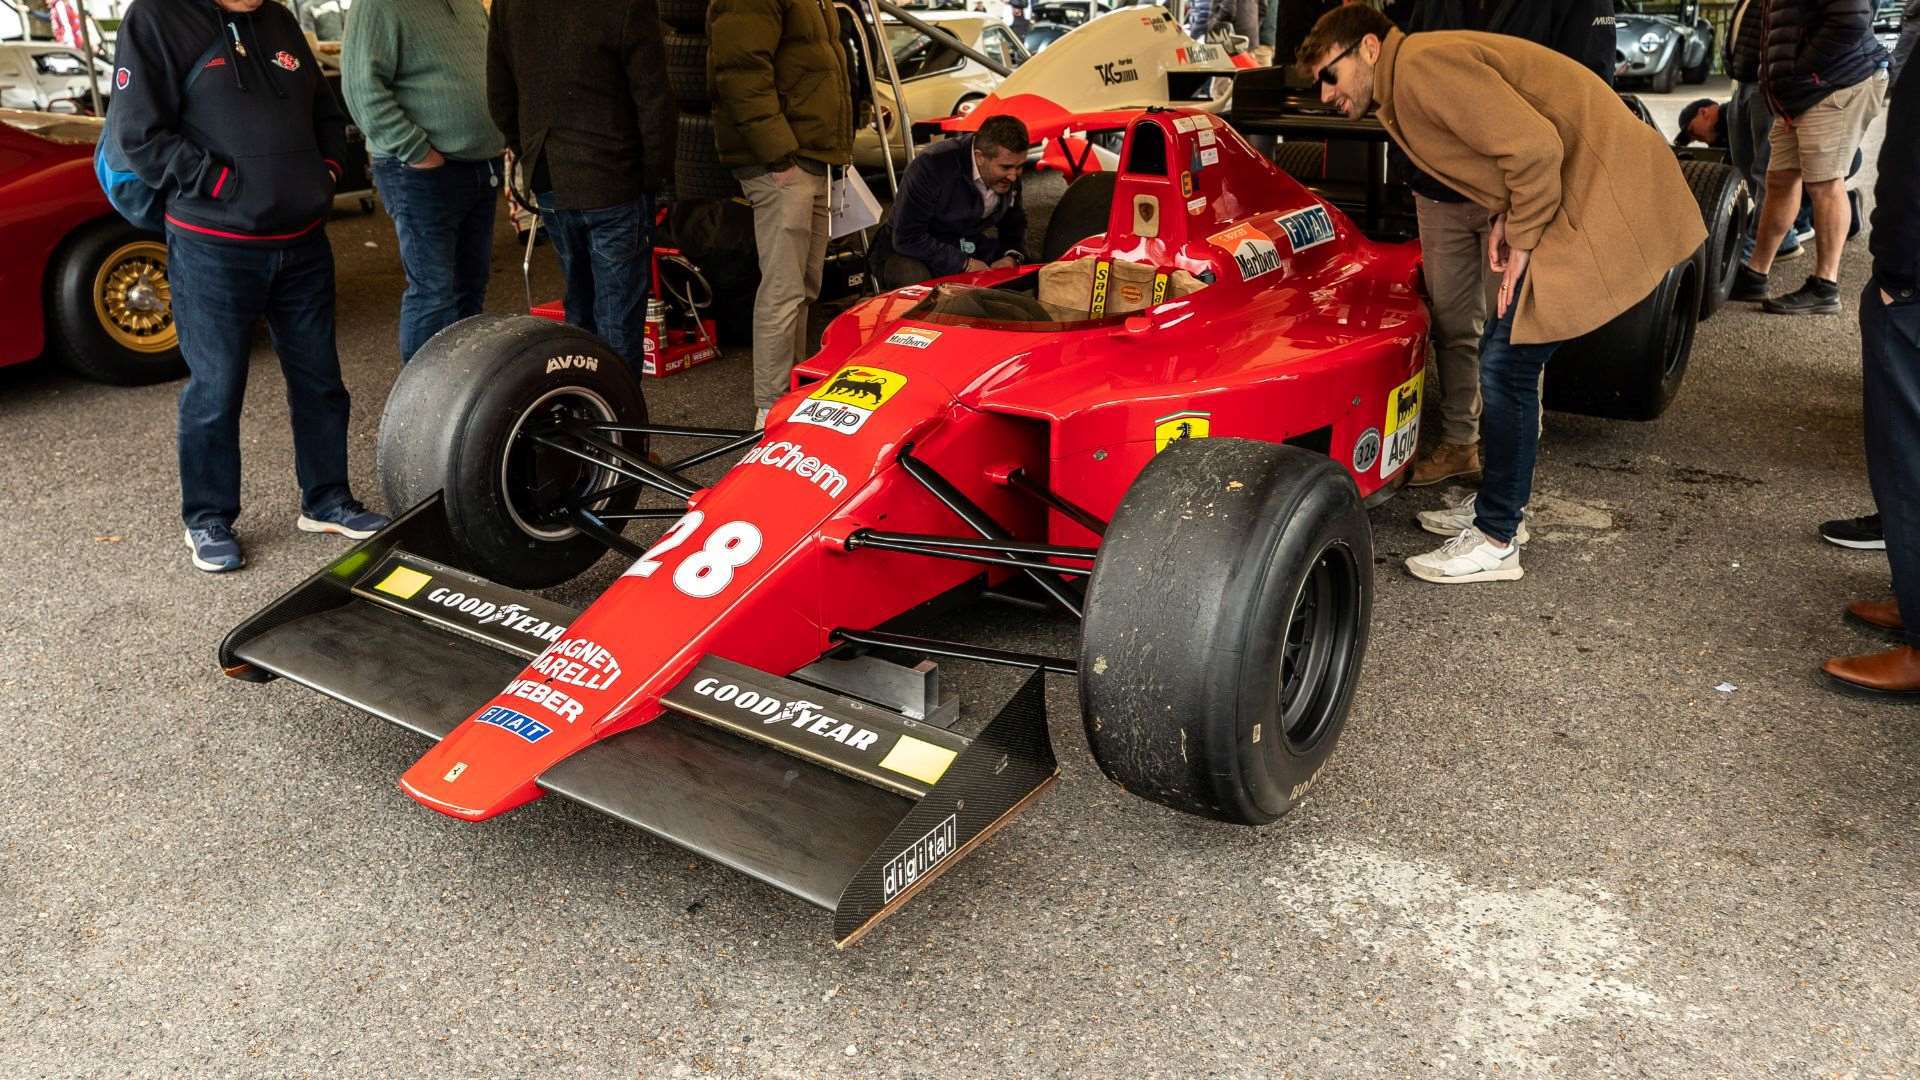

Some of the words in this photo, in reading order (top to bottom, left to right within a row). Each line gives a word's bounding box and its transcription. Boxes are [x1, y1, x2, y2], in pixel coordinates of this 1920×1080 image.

[1591, 16, 1616, 26] MUST
[1285, 211, 1332, 244] FIAT
[1235, 241, 1280, 279] Marlboro
[1094, 269, 1108, 313] Sabe
[546, 355, 598, 374] AVON
[665, 359, 683, 371] SKF
[796, 401, 861, 429] Agip
[1357, 441, 1376, 465] 326
[1388, 422, 1417, 466] Agip
[735, 441, 848, 499] niChem
[620, 510, 763, 598] 28
[531, 655, 622, 691] ARELLI
[501, 679, 584, 725] WEBER
[480, 707, 547, 738] FIAT
[885, 824, 952, 895] digital
